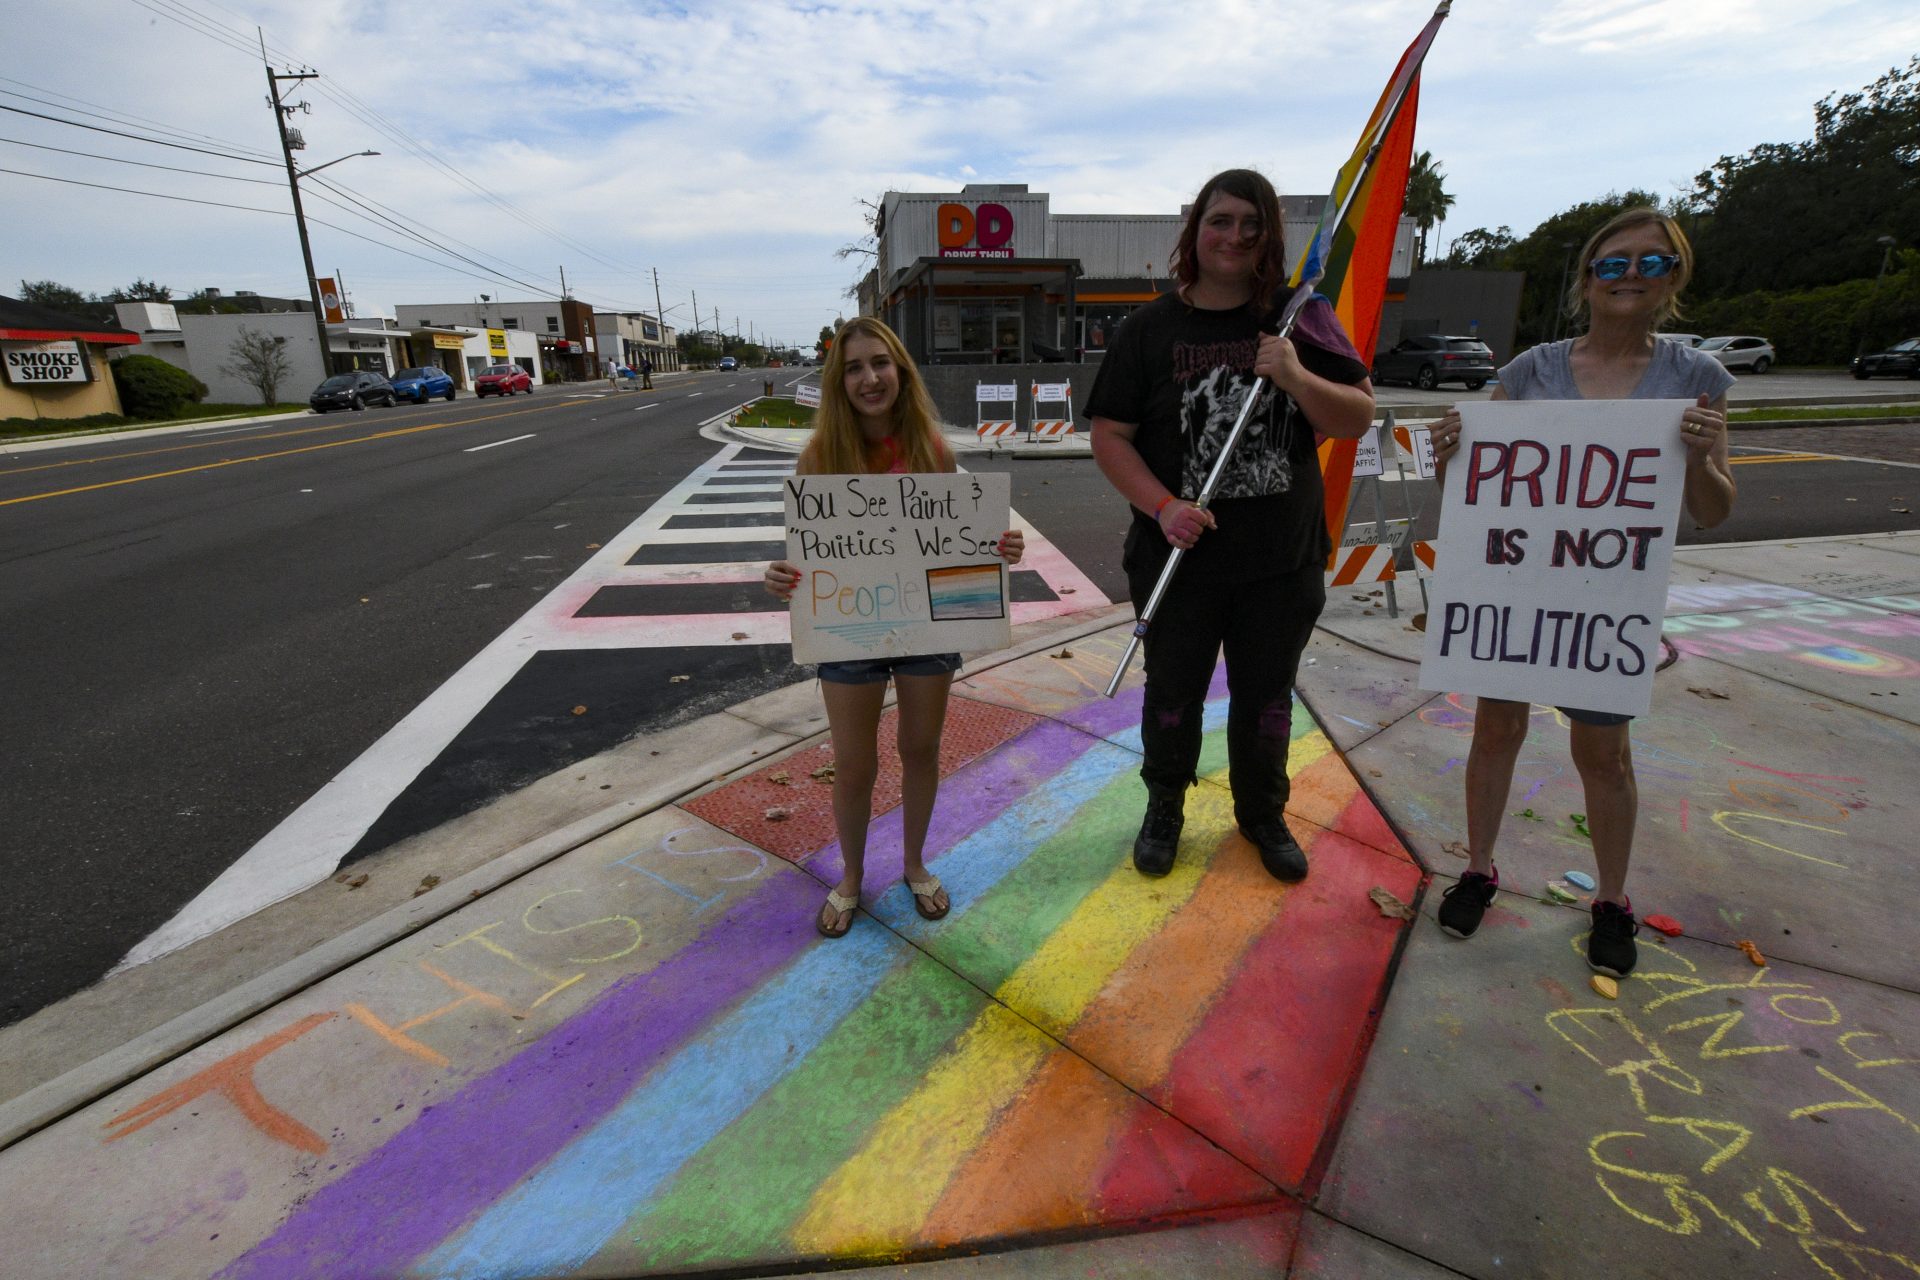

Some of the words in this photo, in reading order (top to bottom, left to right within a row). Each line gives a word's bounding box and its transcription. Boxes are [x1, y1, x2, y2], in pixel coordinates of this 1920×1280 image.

[937, 203, 1014, 248] DD
[944, 250, 977, 258] DRIVE
[979, 250, 1009, 258] THRU
[8, 352, 79, 366] SMOKE
[21, 366, 74, 380] SHOP
[1464, 439, 1661, 510] PRIDE
[787, 478, 838, 521] You
[846, 478, 889, 518] See
[898, 477, 959, 521] Paint
[915, 526, 952, 557] We
[958, 526, 1002, 557] See
[1485, 527, 1529, 566] IS
[1549, 526, 1664, 571] NOT
[811, 569, 922, 621] People
[1440, 601, 1651, 677] POLITICS
[102, 889, 643, 1157] THIS
